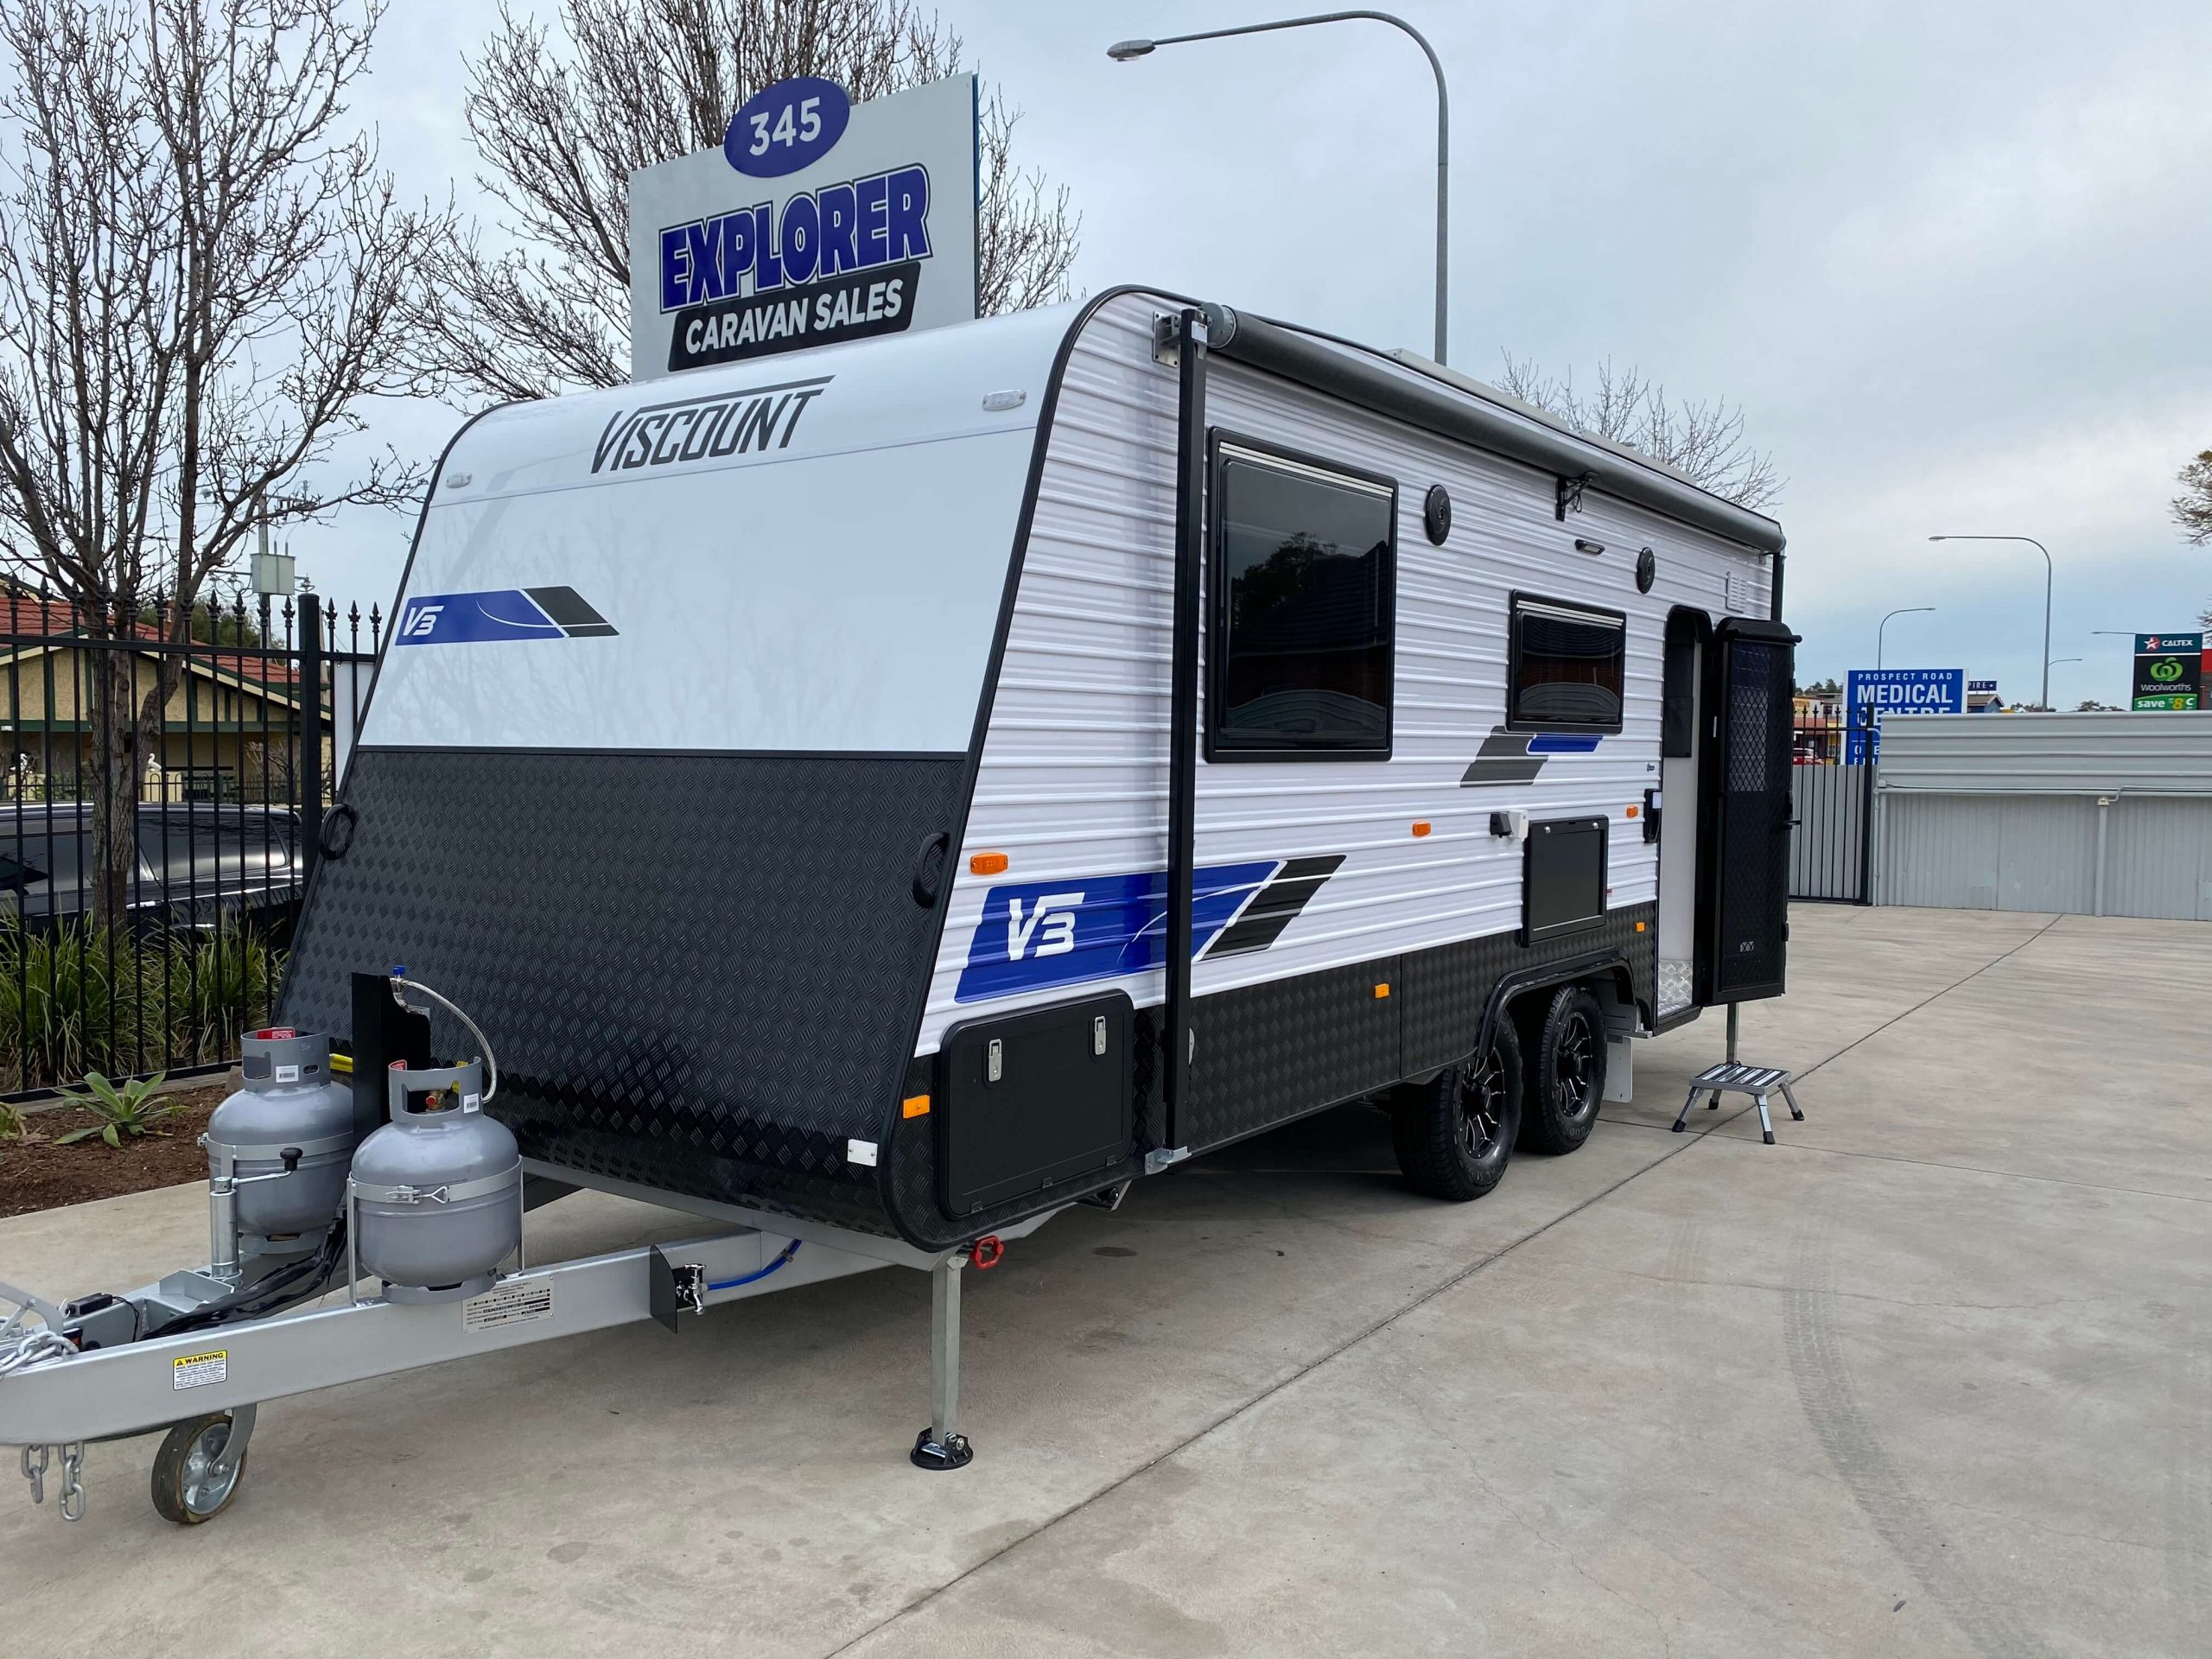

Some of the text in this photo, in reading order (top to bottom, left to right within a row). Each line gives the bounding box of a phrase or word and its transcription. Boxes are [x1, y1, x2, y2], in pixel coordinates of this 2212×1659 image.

[749, 97, 821, 156] 345
[659, 162, 932, 314] EXPLORER
[685, 278, 904, 354] CARAVAN SALES
[591, 375, 836, 474] VISCOUNT
[404, 605, 445, 636] V3
[1857, 684, 1953, 703] MEDICAL
[1007, 892, 1085, 961] V3
[185, 1352, 224, 1364] WARNING
